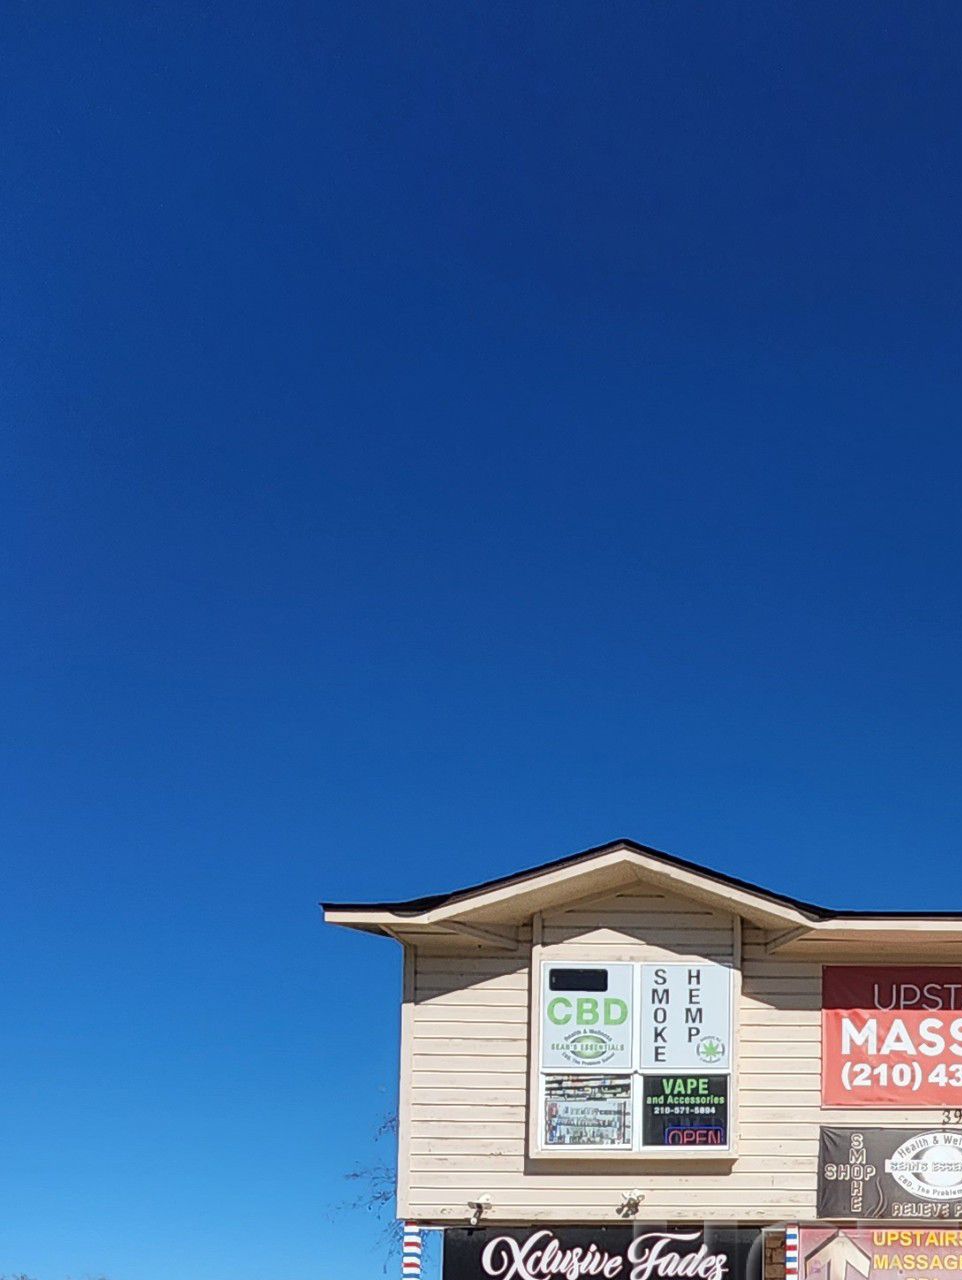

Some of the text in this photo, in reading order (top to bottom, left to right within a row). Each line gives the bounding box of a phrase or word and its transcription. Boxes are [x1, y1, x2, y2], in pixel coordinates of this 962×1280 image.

[546, 997, 629, 1026] CBD
[651, 969, 670, 1063] SMOKE
[684, 969, 703, 1043] HEMP
[662, 1078, 709, 1094] VAPE
[841, 1062, 922, 1091] (210)
[646, 1095, 725, 1105] and Accessories
[668, 1129, 721, 1145] OPEN
[897, 1138, 929, 1159] Health
[932, 1135, 939, 1145] &
[824, 1163, 876, 1181] SHOP
[891, 1202, 950, 1217] RELIEVE
